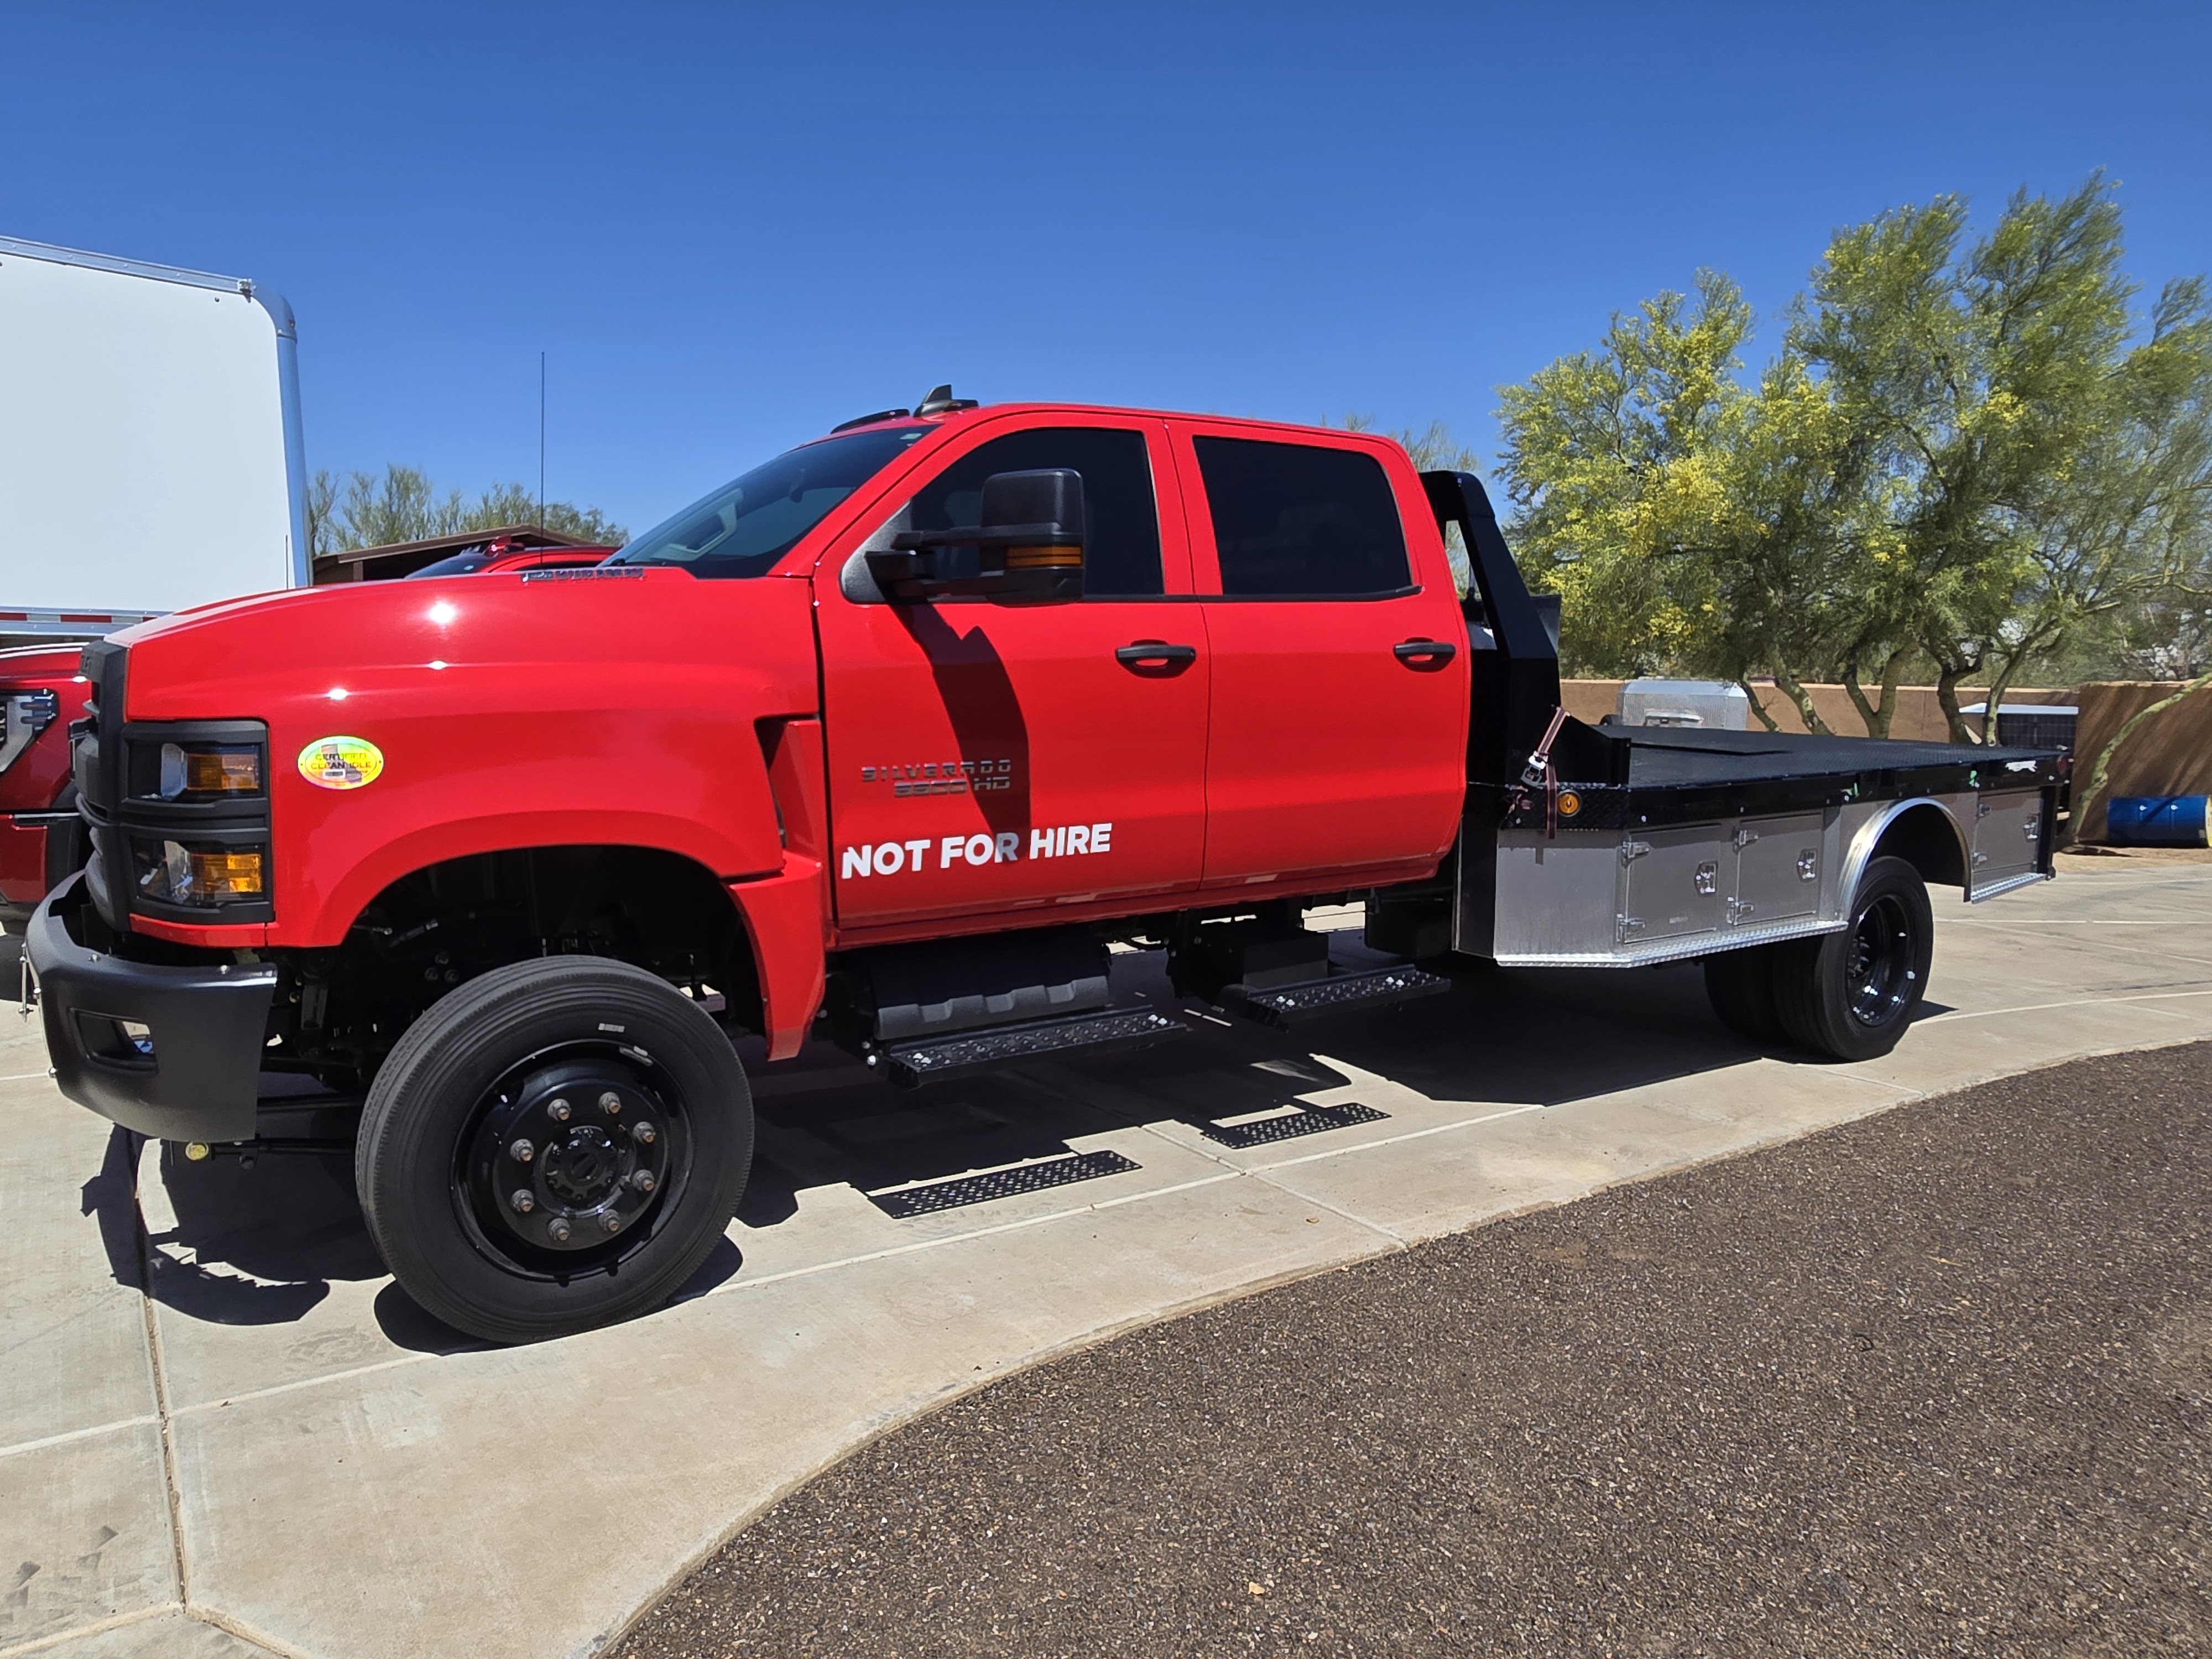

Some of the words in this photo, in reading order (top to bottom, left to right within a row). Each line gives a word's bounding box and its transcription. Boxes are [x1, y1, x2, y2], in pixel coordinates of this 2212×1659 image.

[862, 759, 1011, 781] SILVERADO
[974, 776, 1010, 791] HD
[842, 839, 931, 879] NOT
[941, 832, 1019, 869] FOR
[1029, 823, 1112, 859] HIRE
